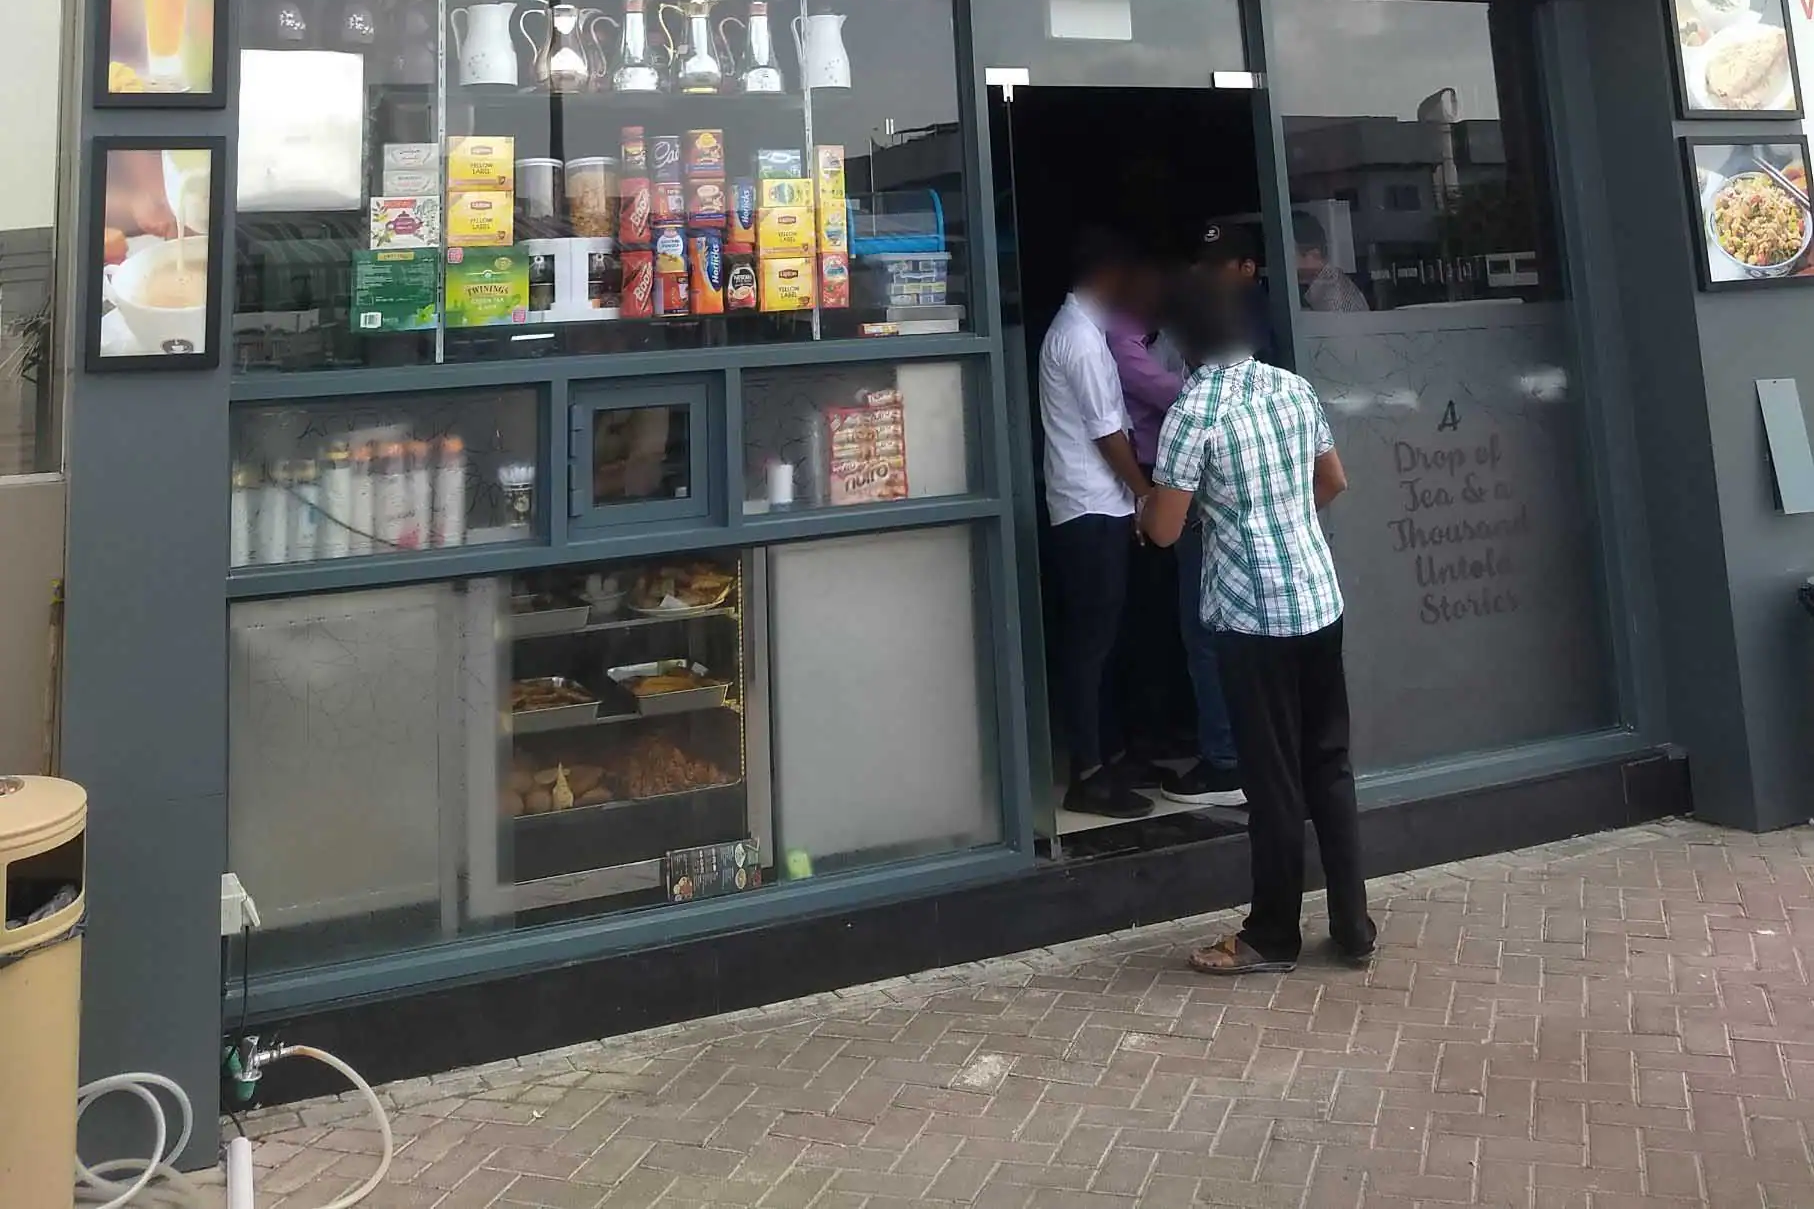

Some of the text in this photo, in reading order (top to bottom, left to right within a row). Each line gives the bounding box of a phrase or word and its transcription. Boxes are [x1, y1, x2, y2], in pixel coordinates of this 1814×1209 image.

[467, 285, 509, 297] TWININGS
[1437, 399, 1461, 432] A
[1394, 433, 1502, 478] Drop of
[1400, 477, 1454, 512] Tea
[1462, 472, 1486, 504] &
[1387, 504, 1531, 553] Thousand
[1419, 589, 1521, 626] Stories
